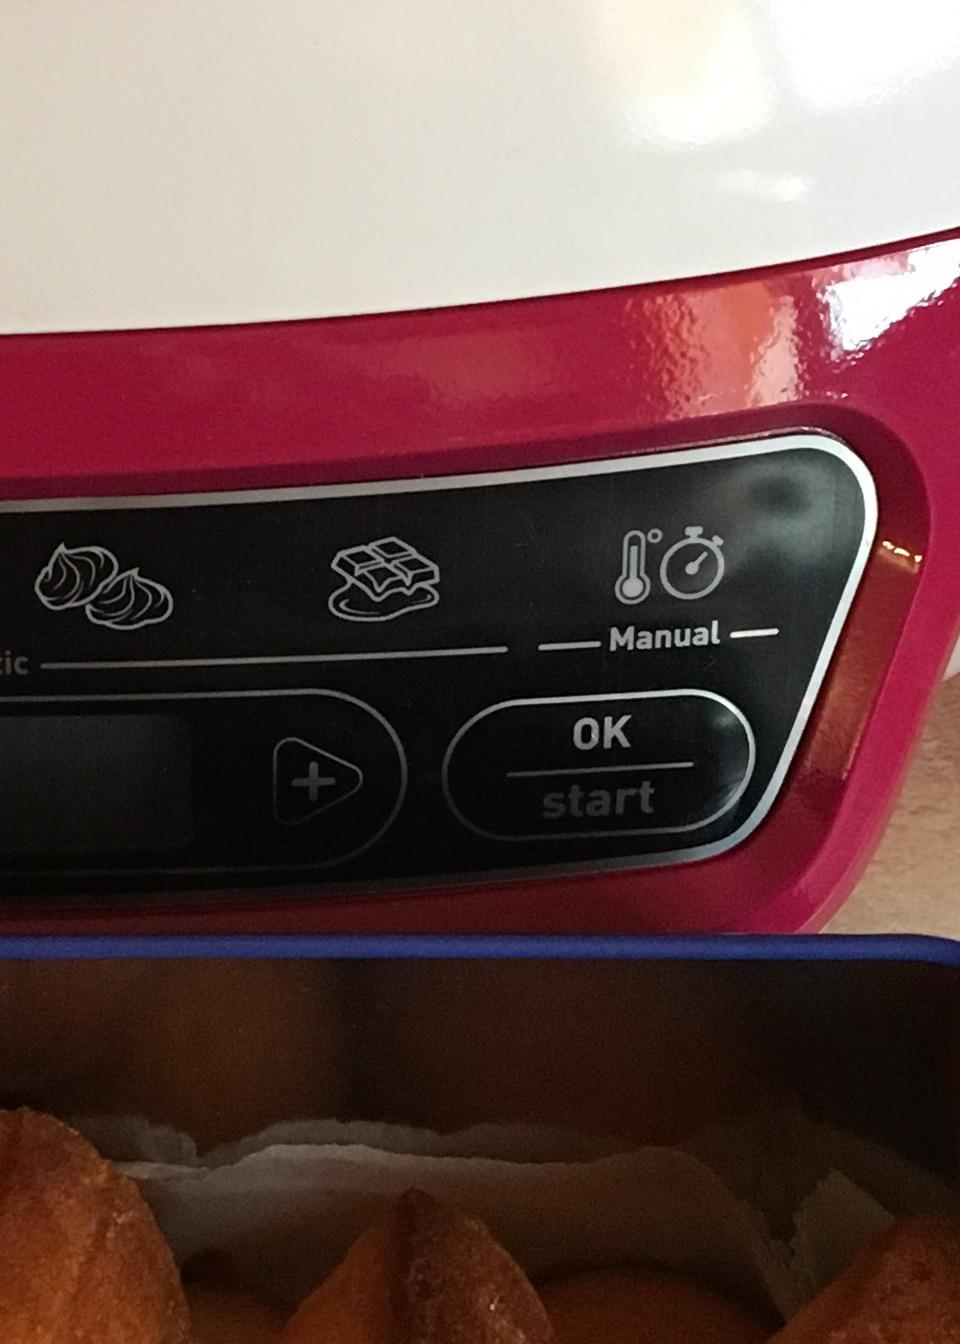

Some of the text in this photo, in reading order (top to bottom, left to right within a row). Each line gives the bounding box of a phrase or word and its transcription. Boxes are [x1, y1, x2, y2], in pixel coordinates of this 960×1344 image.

[608, 619, 721, 653] Manual
[572, 714, 633, 750] OK
[541, 781, 655, 818] start
